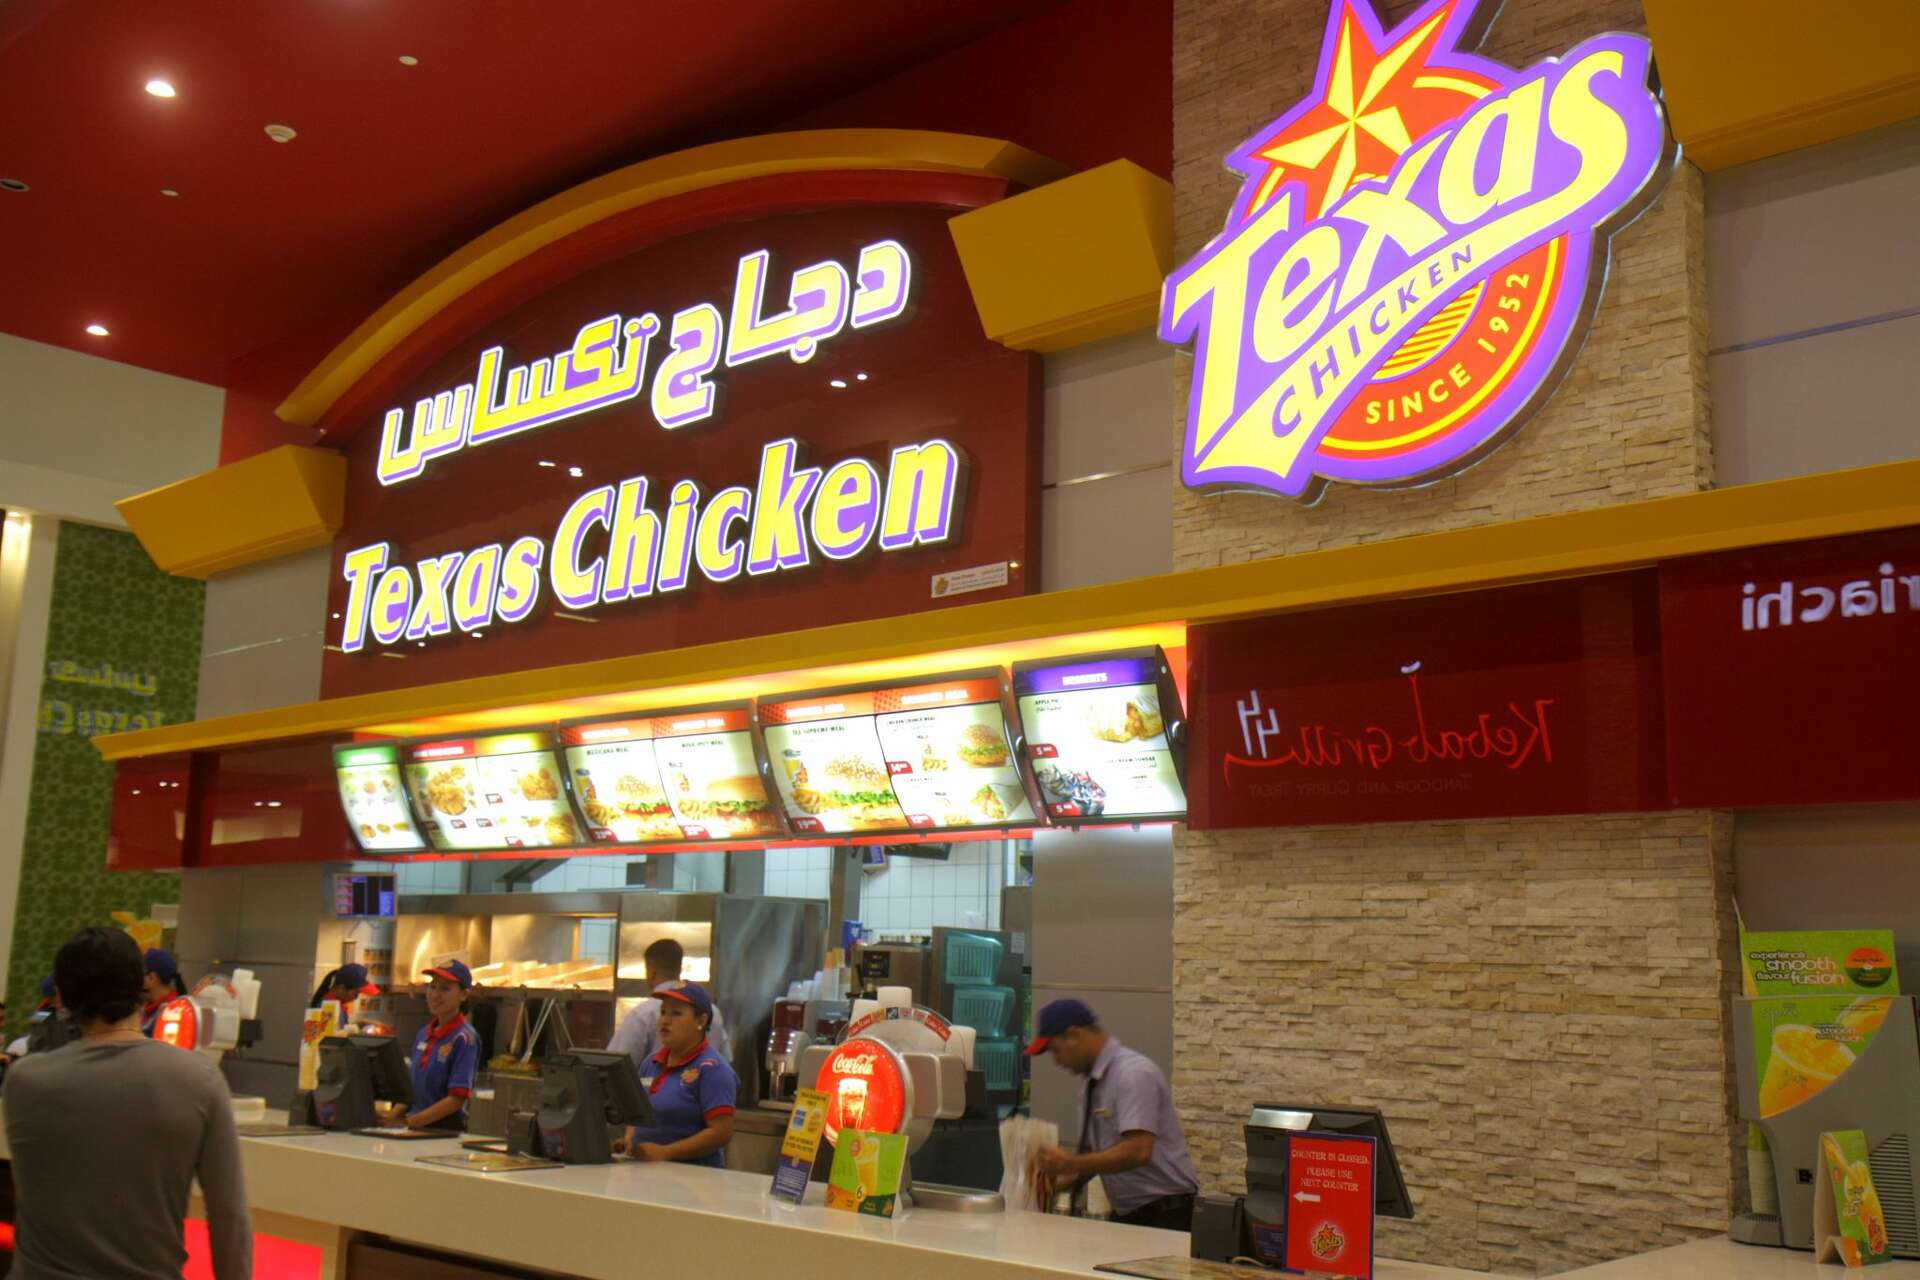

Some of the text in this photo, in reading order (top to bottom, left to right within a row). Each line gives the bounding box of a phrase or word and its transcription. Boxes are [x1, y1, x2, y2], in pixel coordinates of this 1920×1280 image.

[1171, 49, 1629, 474] Texas
[377, 240, 911, 486] دجاج تكساس
[1271, 245, 1473, 437] CHICKEN
[1365, 272, 1531, 426] SINCE 1952
[341, 437, 960, 652] Texas Chicken
[1766, 956, 1837, 971] smooth
[1792, 970, 1845, 985] fusion
[1306, 1167, 1353, 1179] PLEASE USE
[1322, 1179, 1359, 1192] COUNTER
